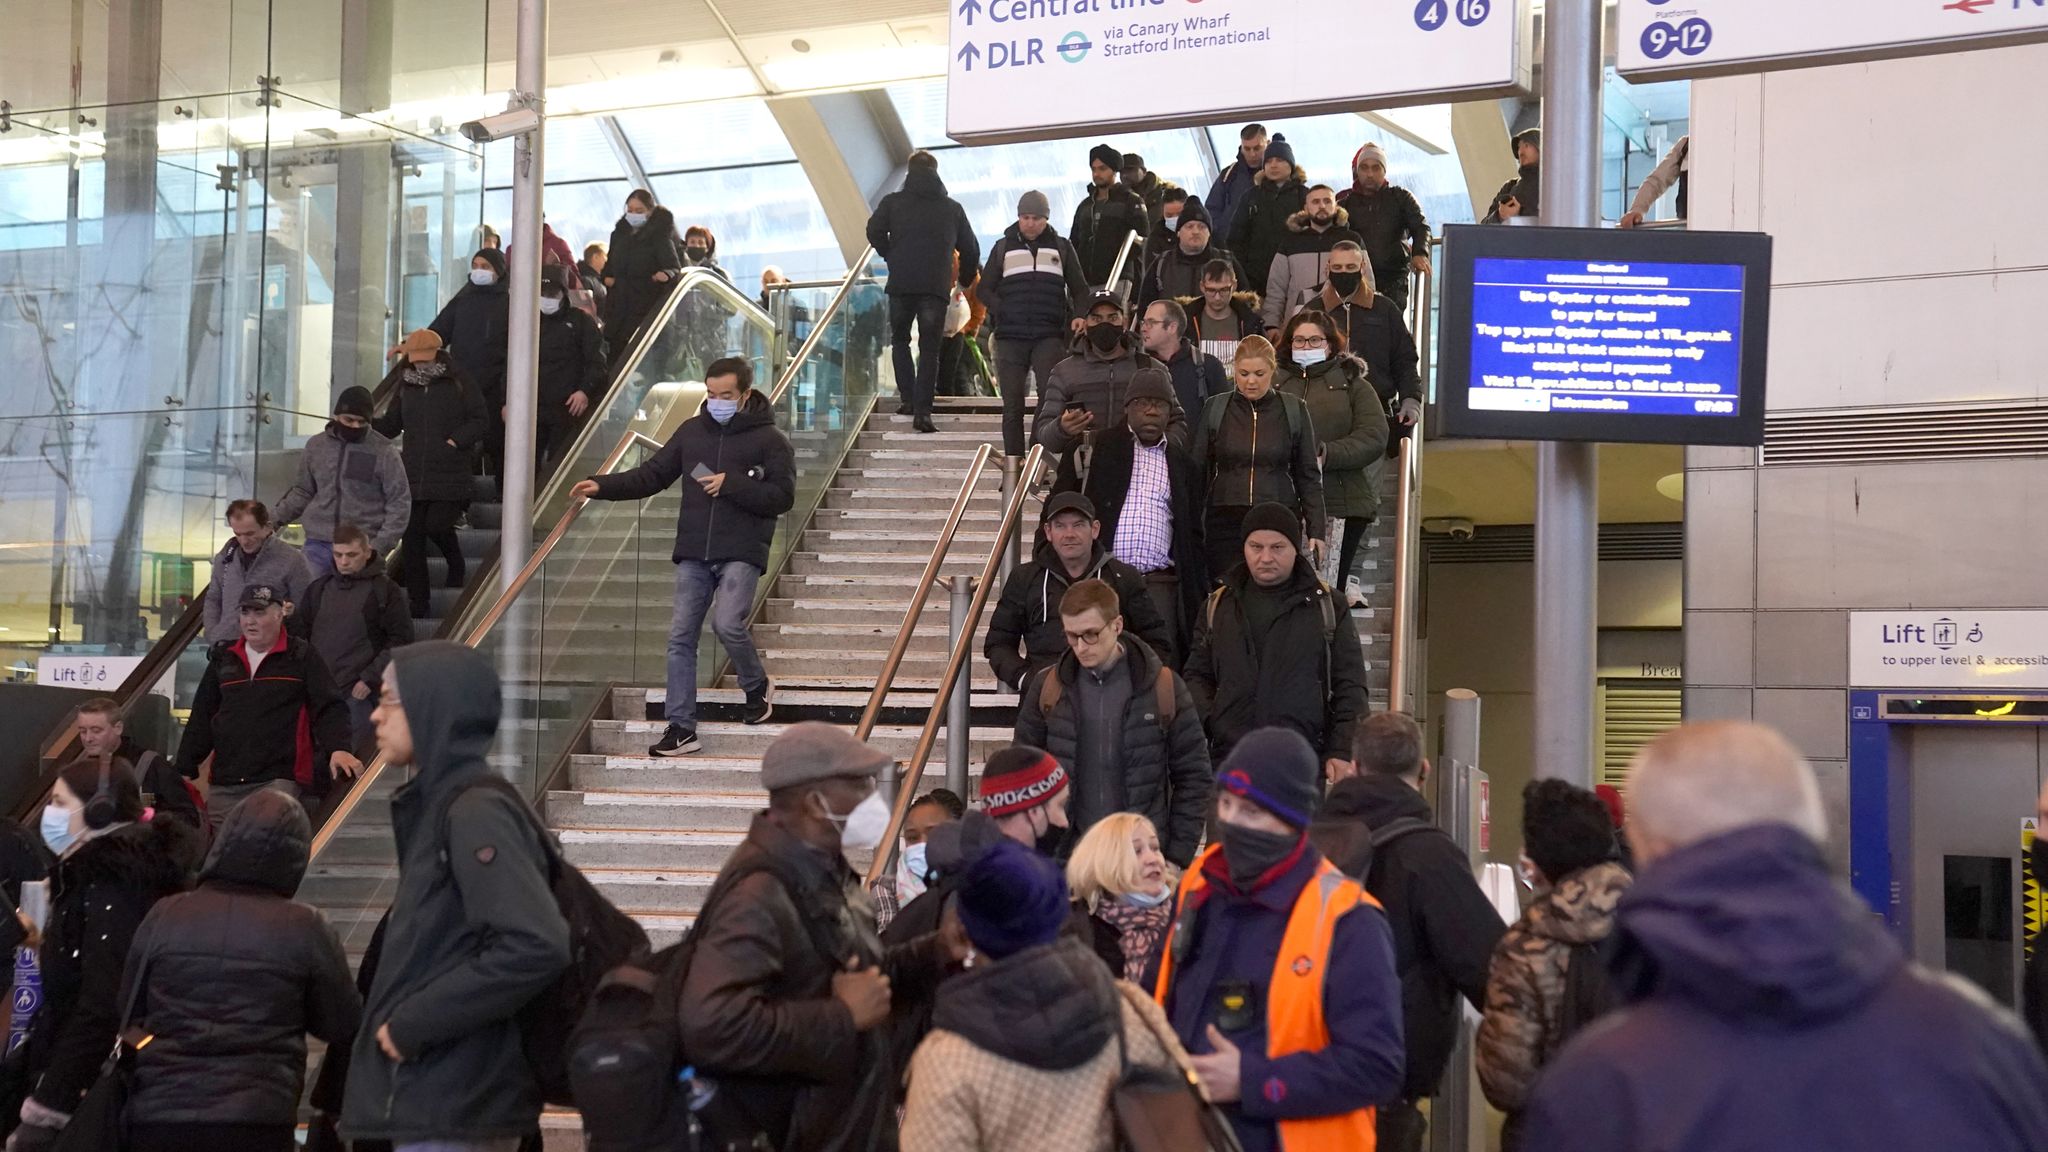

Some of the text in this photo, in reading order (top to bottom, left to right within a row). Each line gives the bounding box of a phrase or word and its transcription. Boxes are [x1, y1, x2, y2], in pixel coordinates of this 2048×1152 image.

[1421, 2, 1438, 24] 4
[1462, 0, 1486, 20] 16
[1104, 13, 1230, 39] via Canary Wharf
[1104, 27, 1271, 57] Stratford International
[1650, 24, 1706, 52] 9-12
[988, 38, 1045, 69] DLR
[1883, 624, 1925, 643] Lift
[1641, 662, 1681, 677] Brea
[1883, 655, 2048, 668] to upper level & accessib
[53, 668, 76, 681] Lift
